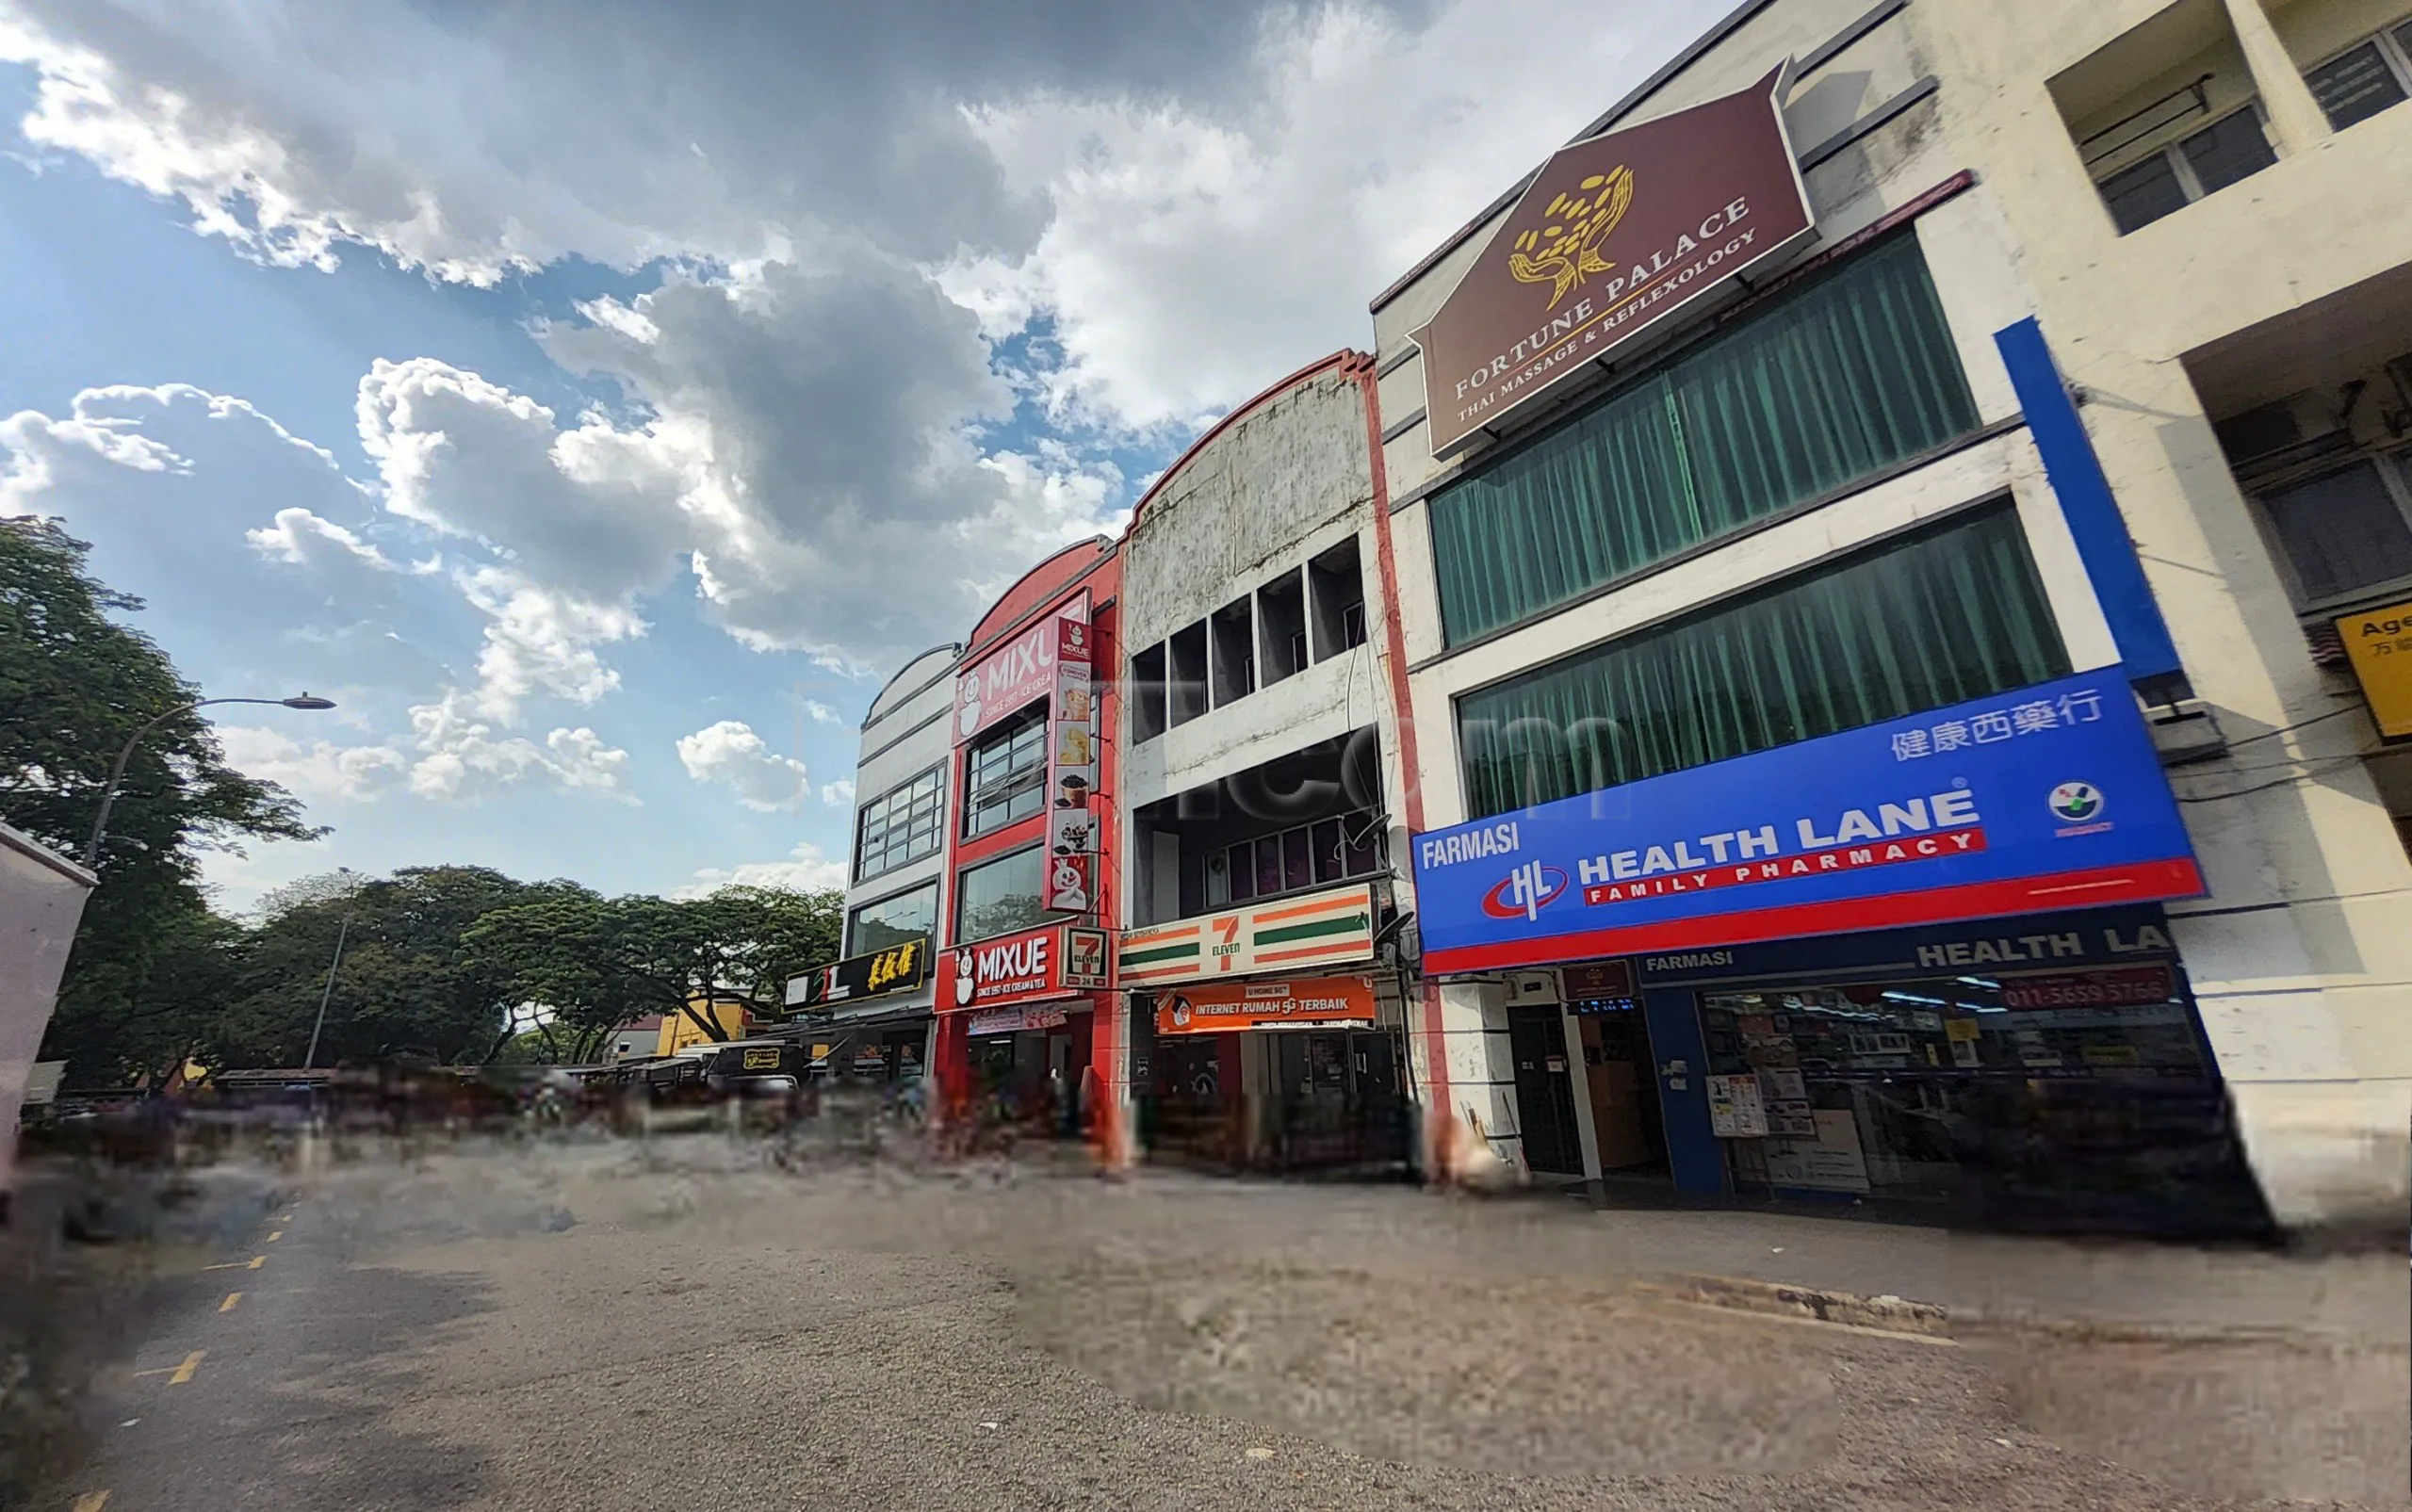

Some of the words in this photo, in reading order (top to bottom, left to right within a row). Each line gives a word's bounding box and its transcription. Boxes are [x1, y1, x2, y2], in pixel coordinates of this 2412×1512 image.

[1455, 297, 1594, 400] FORTUNE
[1606, 196, 1751, 303] PALACE
[1457, 392, 1496, 423] THAI
[1501, 341, 1579, 394] MASSAGE
[1585, 330, 1597, 344] &
[1603, 227, 1758, 333] REFLEXOLOGY
[1061, 642, 1090, 657] MIXUE
[985, 699, 1004, 717] SINCE
[1033, 671, 1051, 690] CREA
[1890, 688, 2104, 762] 健康西藥行
[1422, 821, 1520, 870] FARMASI
[1577, 825, 1780, 885] HEALTH
[1796, 788, 1980, 850] LANE
[1511, 858, 1553, 921] HL
[1590, 872, 1708, 902] FAMILY
[1736, 833, 1974, 882] PHARMACY
[977, 936, 1049, 984] MIXUE
[1646, 950, 1734, 972] FARMASI
[1915, 931, 2085, 968] HEALTH
[1196, 1002, 1241, 1016] INTERNET
[1242, 1000, 1279, 1014] RUMAH
[1281, 998, 1296, 1016] 5G
[1298, 997, 1348, 1012] TERBAIK
